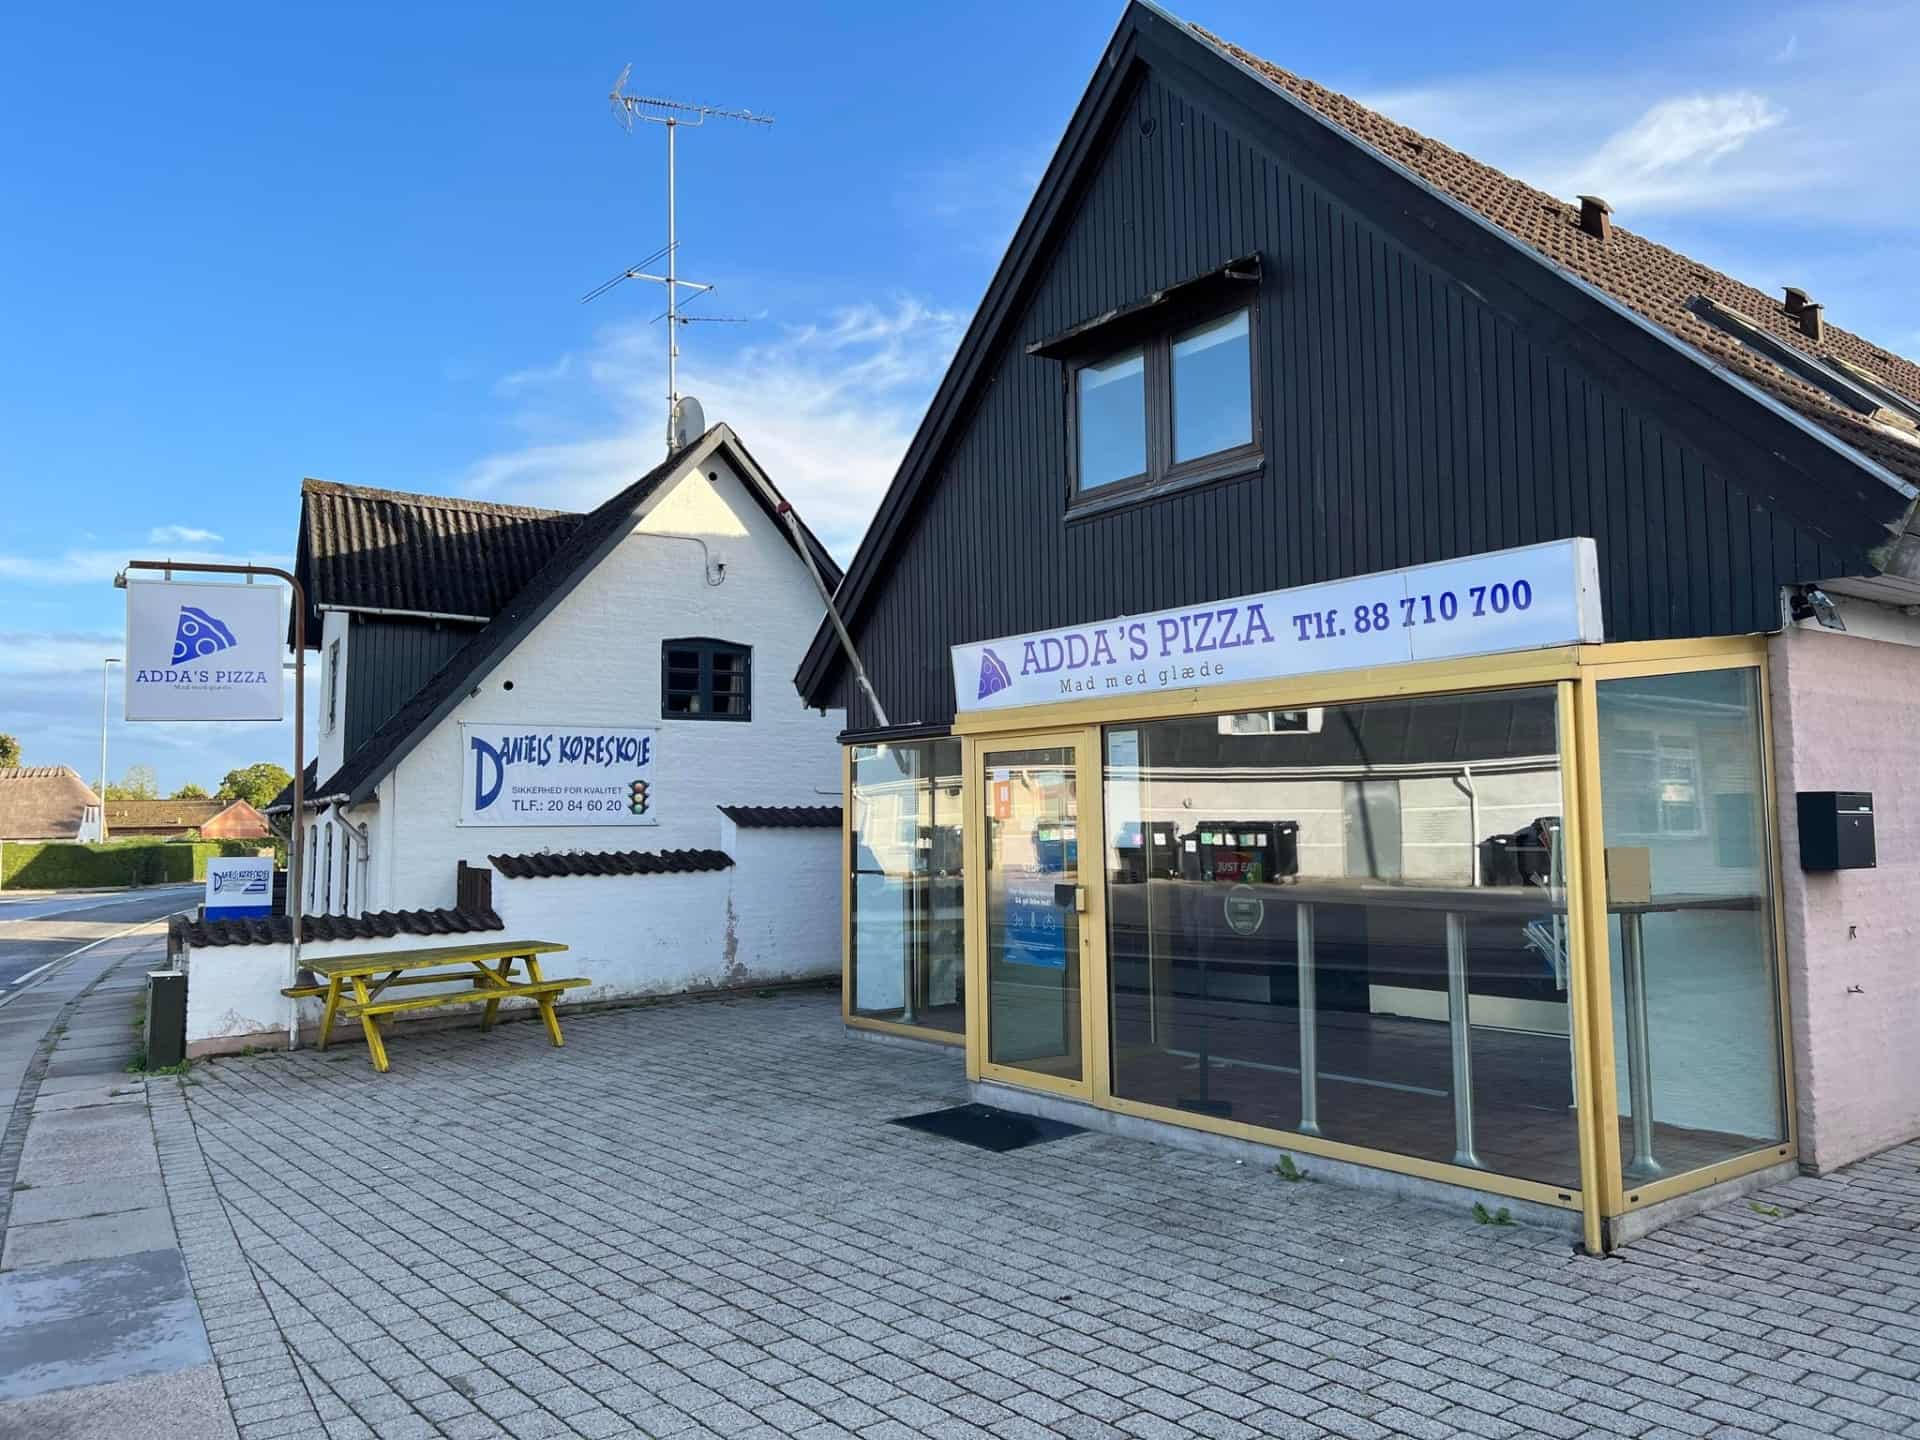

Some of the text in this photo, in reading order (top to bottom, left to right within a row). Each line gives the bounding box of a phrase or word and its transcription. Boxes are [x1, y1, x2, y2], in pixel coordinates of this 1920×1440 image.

[1020, 579, 1533, 676] ADDA'S PIZZA Tlf. 88 710 700
[136, 670, 268, 683] ADDA'S PIZZA
[1060, 661, 1225, 694] Mad med glæde
[558, 735, 650, 768] KØRESKOLE
[511, 786, 562, 794] SIKKERHED
[564, 786, 582, 794] FOR
[511, 799, 622, 812] TLF.: 20 84 60 20
[1217, 862, 1238, 872] JUST
